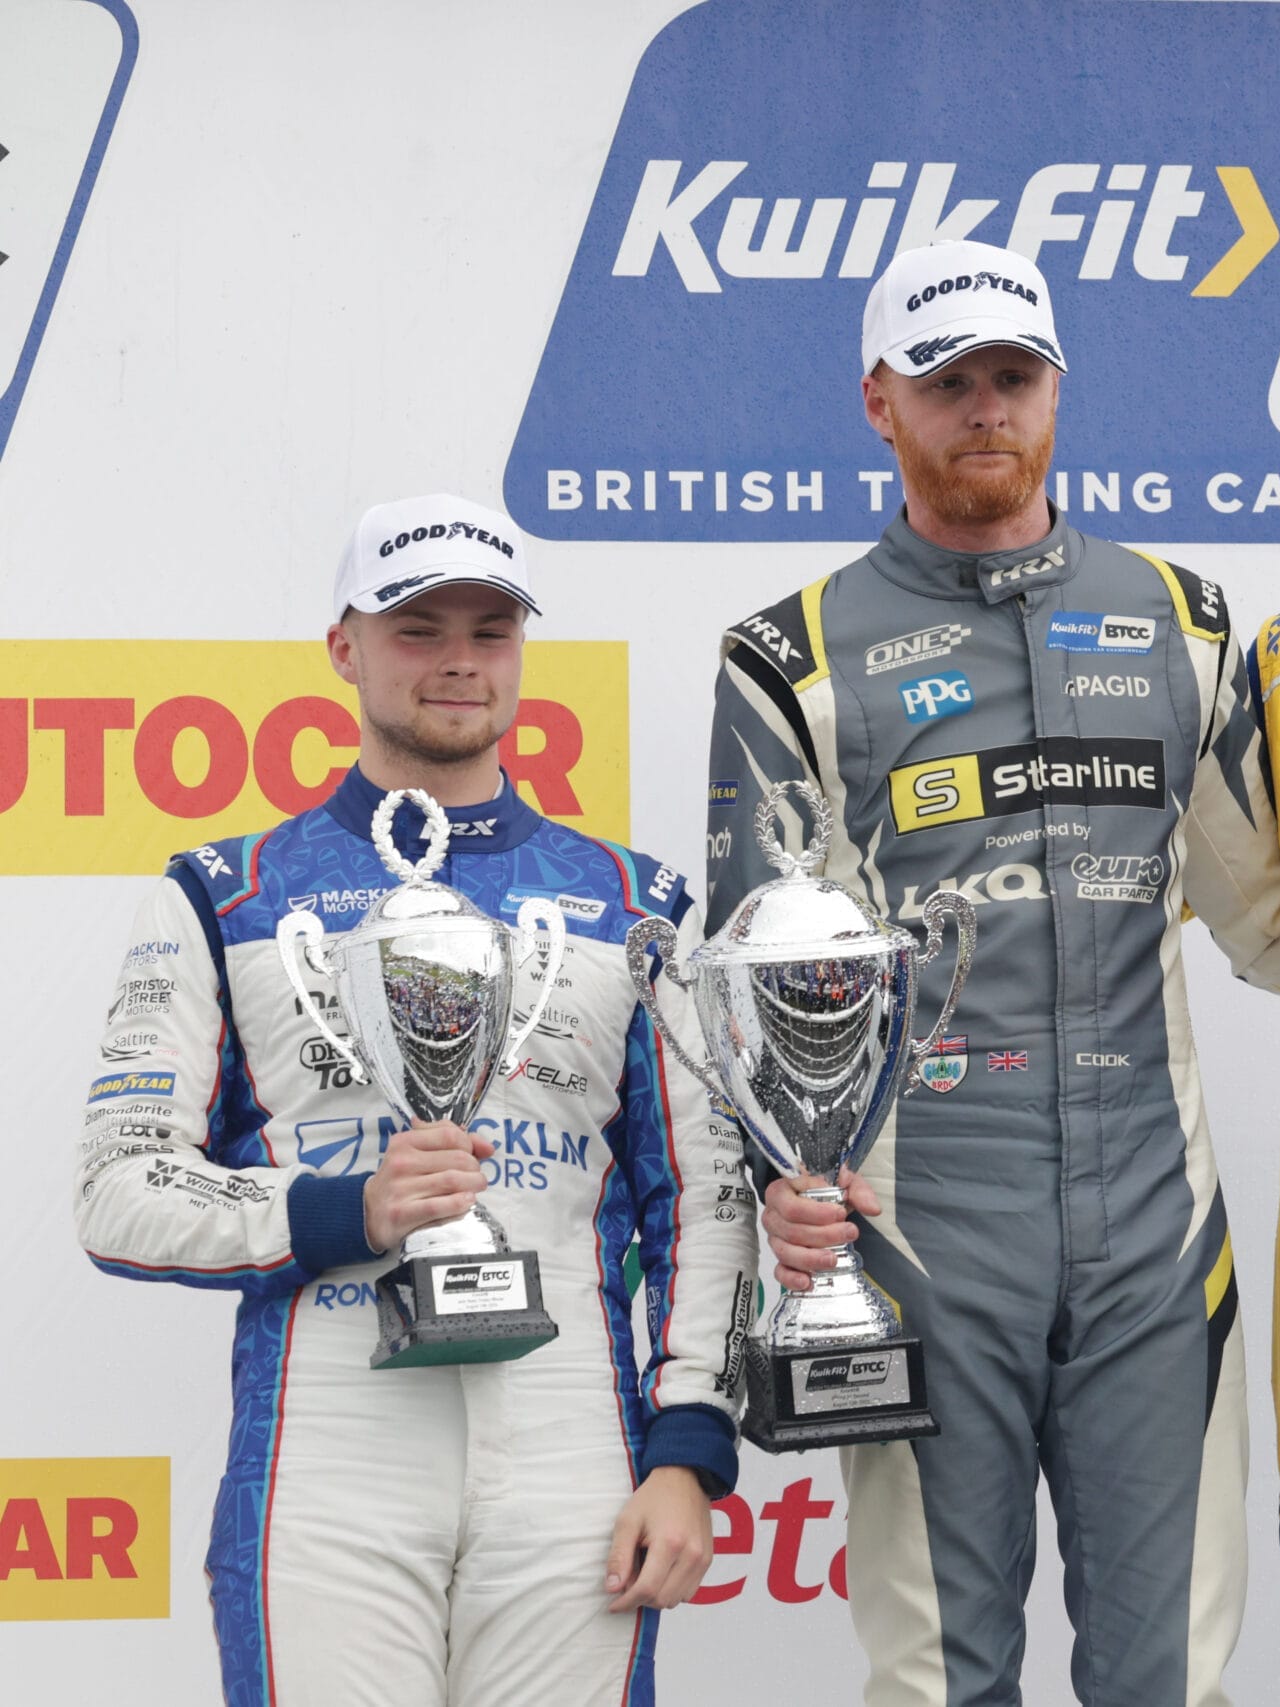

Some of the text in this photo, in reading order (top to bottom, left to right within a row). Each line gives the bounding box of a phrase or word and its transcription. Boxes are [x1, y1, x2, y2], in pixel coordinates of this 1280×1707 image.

[907, 272, 1038, 312] GOODYEAR
[547, 469, 823, 511] BRITISH
[858, 471, 1172, 512] TING
[379, 522, 514, 559] GOODYEAR
[991, 545, 1066, 586] HRX
[1201, 581, 1218, 619] HR
[743, 616, 803, 664] HRX
[1104, 624, 1151, 640] BTCC
[867, 630, 945, 667] ONE
[871, 649, 946, 673] MOTORSPORT
[902, 678, 972, 716] PPG
[1076, 675, 1150, 698] PAGID
[0, 695, 584, 819] TOCR
[993, 754, 1156, 800] Starline
[711, 787, 737, 799] YEAR
[985, 822, 1091, 850] Powered by
[321, 888, 387, 903] MACK
[898, 864, 1056, 920] LKQ
[1081, 886, 1155, 901] CAR PARTS
[558, 899, 600, 914] BTCC
[127, 991, 172, 1007] STREET
[129, 979, 178, 994] BRISTOL
[113, 1031, 158, 1049] Saltire
[1076, 1053, 1130, 1067] COOK
[89, 1073, 172, 1098] GOODYEAR
[482, 1271, 510, 1281] BTCC
[314, 1283, 379, 1311] RON
[852, 1361, 885, 1375] BTCC
